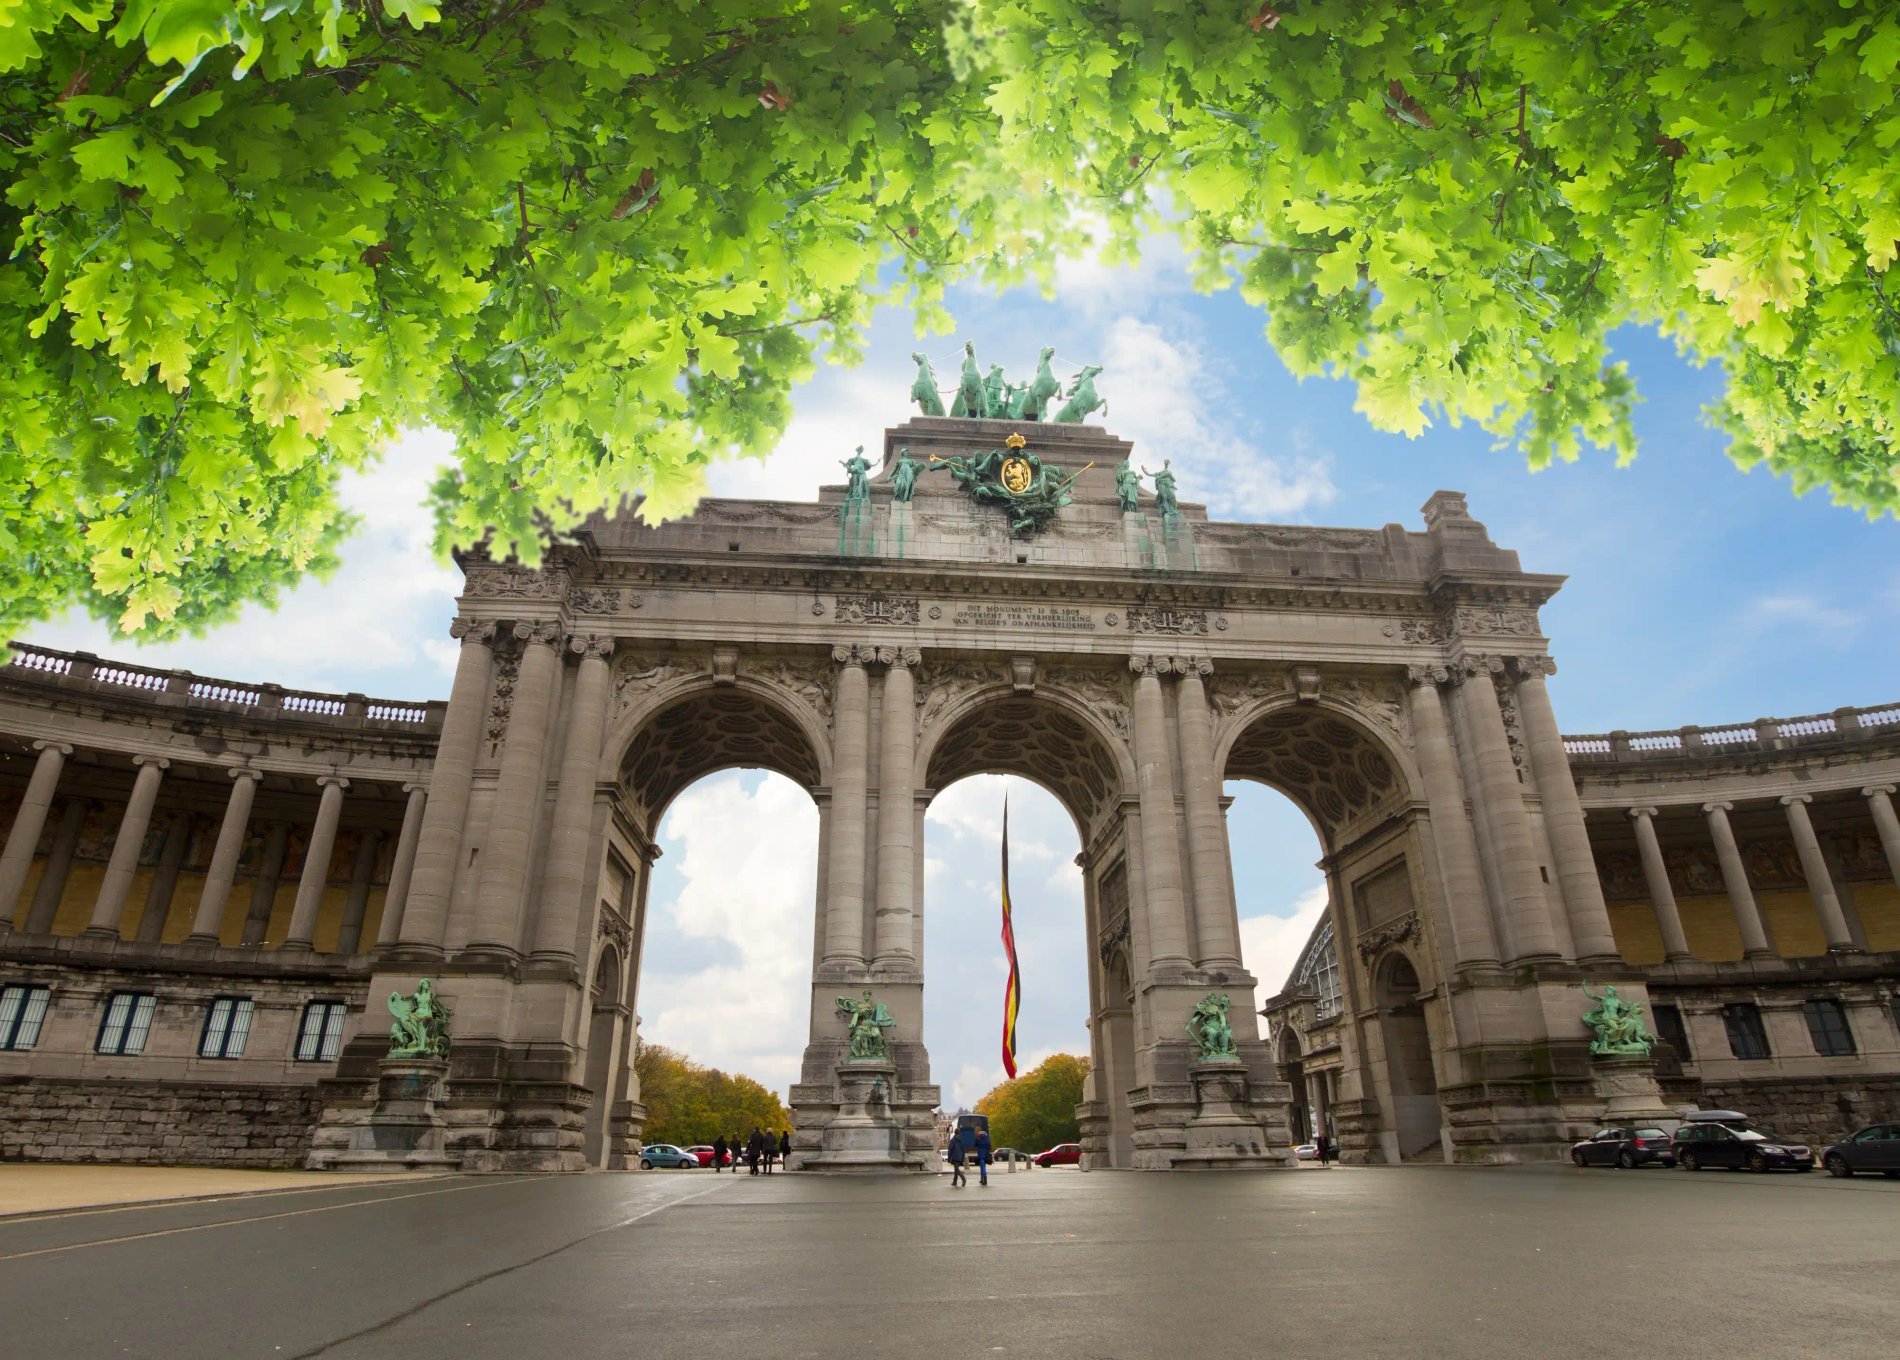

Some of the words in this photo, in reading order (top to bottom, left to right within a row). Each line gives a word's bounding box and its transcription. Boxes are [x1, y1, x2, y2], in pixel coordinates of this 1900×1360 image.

[1027, 614, 1091, 622] VERHEERLIJKING
[952, 617, 969, 625] VAN
[1012, 620, 1096, 630] ONAFHANKELIJKHEID
